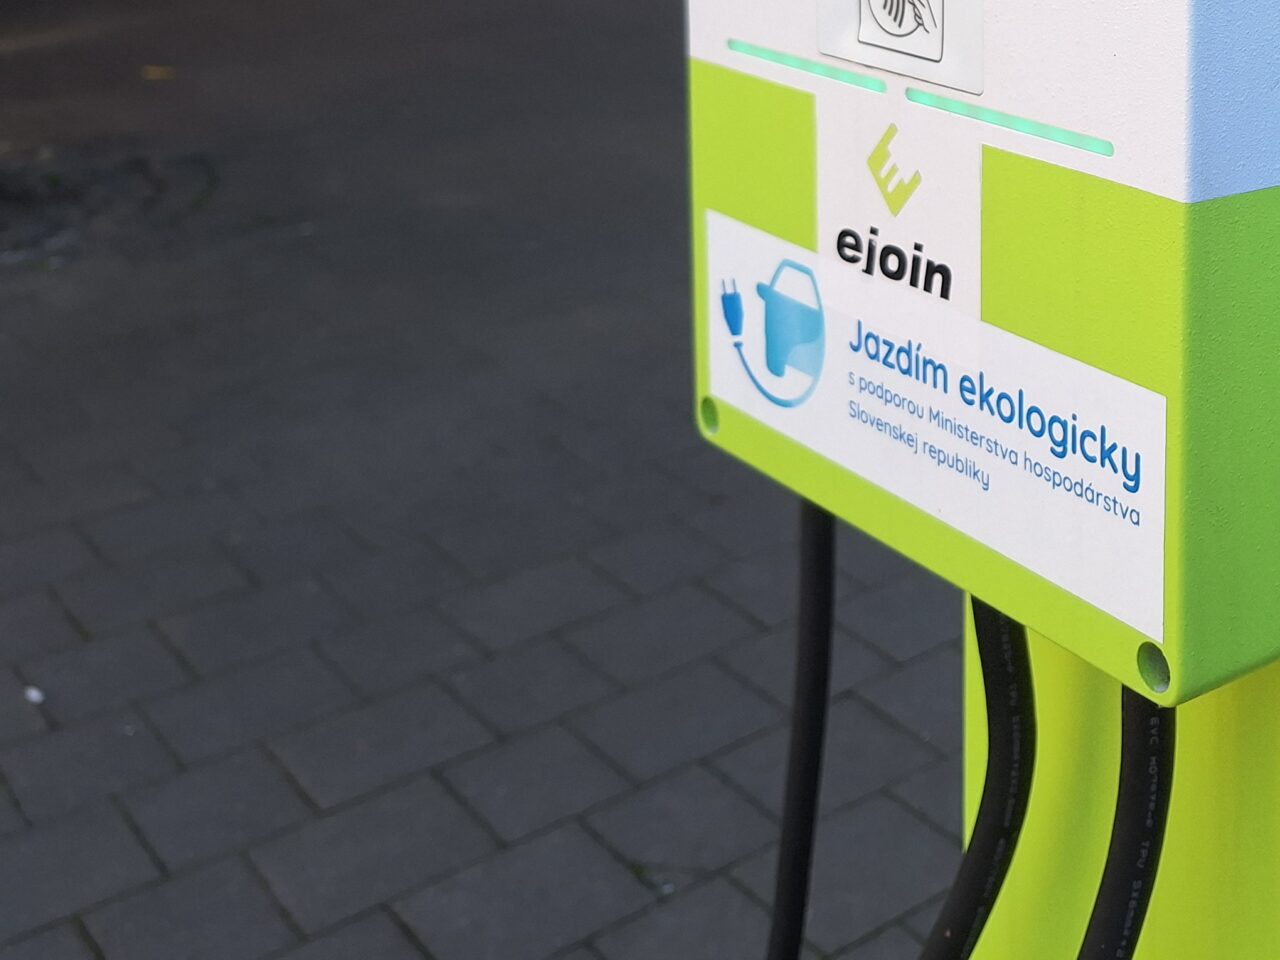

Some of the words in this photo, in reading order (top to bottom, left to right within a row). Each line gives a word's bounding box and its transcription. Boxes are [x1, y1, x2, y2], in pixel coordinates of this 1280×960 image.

[835, 225, 953, 302] ejoin
[848, 319, 950, 395] Jazdím
[958, 370, 1143, 494] ekologicky
[848, 398, 919, 456] Slovenskej
[922, 439, 991, 492] republiky
[848, 372, 857, 387] s
[858, 375, 925, 421] podporou
[928, 404, 1020, 468] Ministerstva
[1022, 449, 1142, 528] hospodárstva
